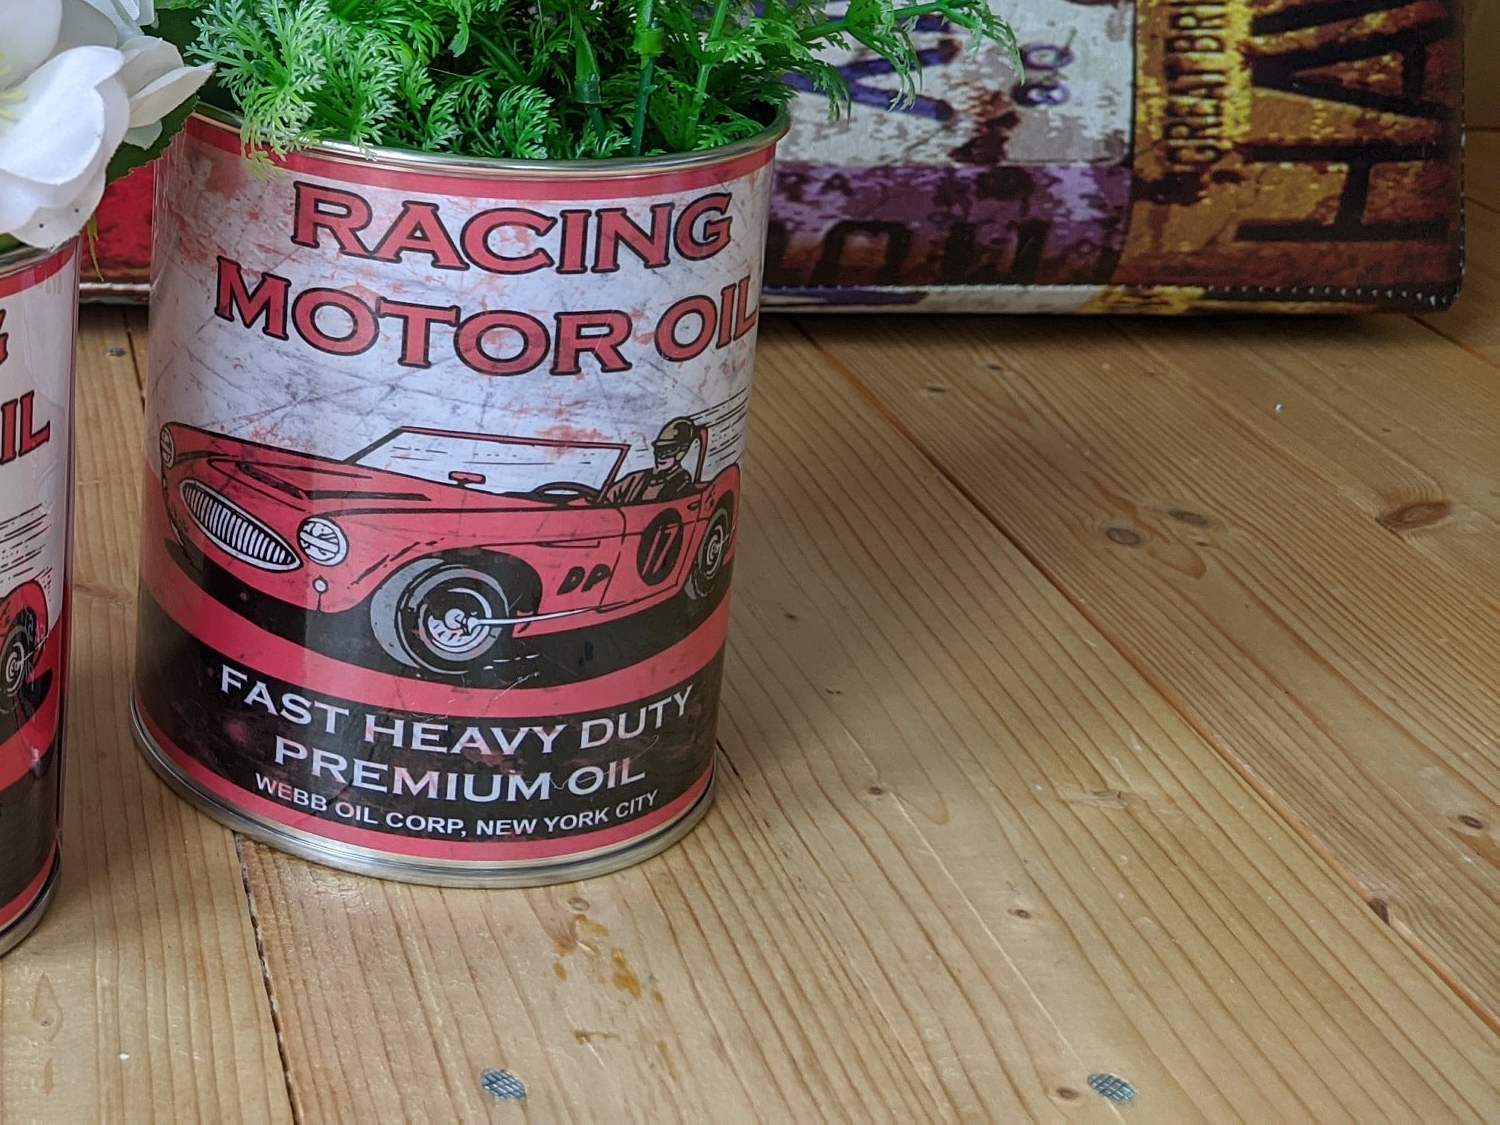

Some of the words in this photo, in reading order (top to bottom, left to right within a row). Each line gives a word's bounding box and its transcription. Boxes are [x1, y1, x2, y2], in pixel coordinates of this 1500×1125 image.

[1164, 56, 1228, 166] GREAT
[291, 180, 733, 275] RACING
[214, 255, 634, 377] MOTOR
[653, 275, 759, 363] OIL
[642, 523, 680, 576] 17
[220, 663, 349, 734] FAST
[364, 714, 574, 758] HEAVY
[579, 685, 694, 751] DUTY
[255, 772, 328, 813] WEBB
[333, 800, 379, 827] OIL
[476, 816, 541, 837] NEW
[543, 807, 609, 834] YORK
[614, 788, 659, 820] CITY
[273, 734, 552, 804] PREMIUM
[567, 756, 647, 798] OIL
